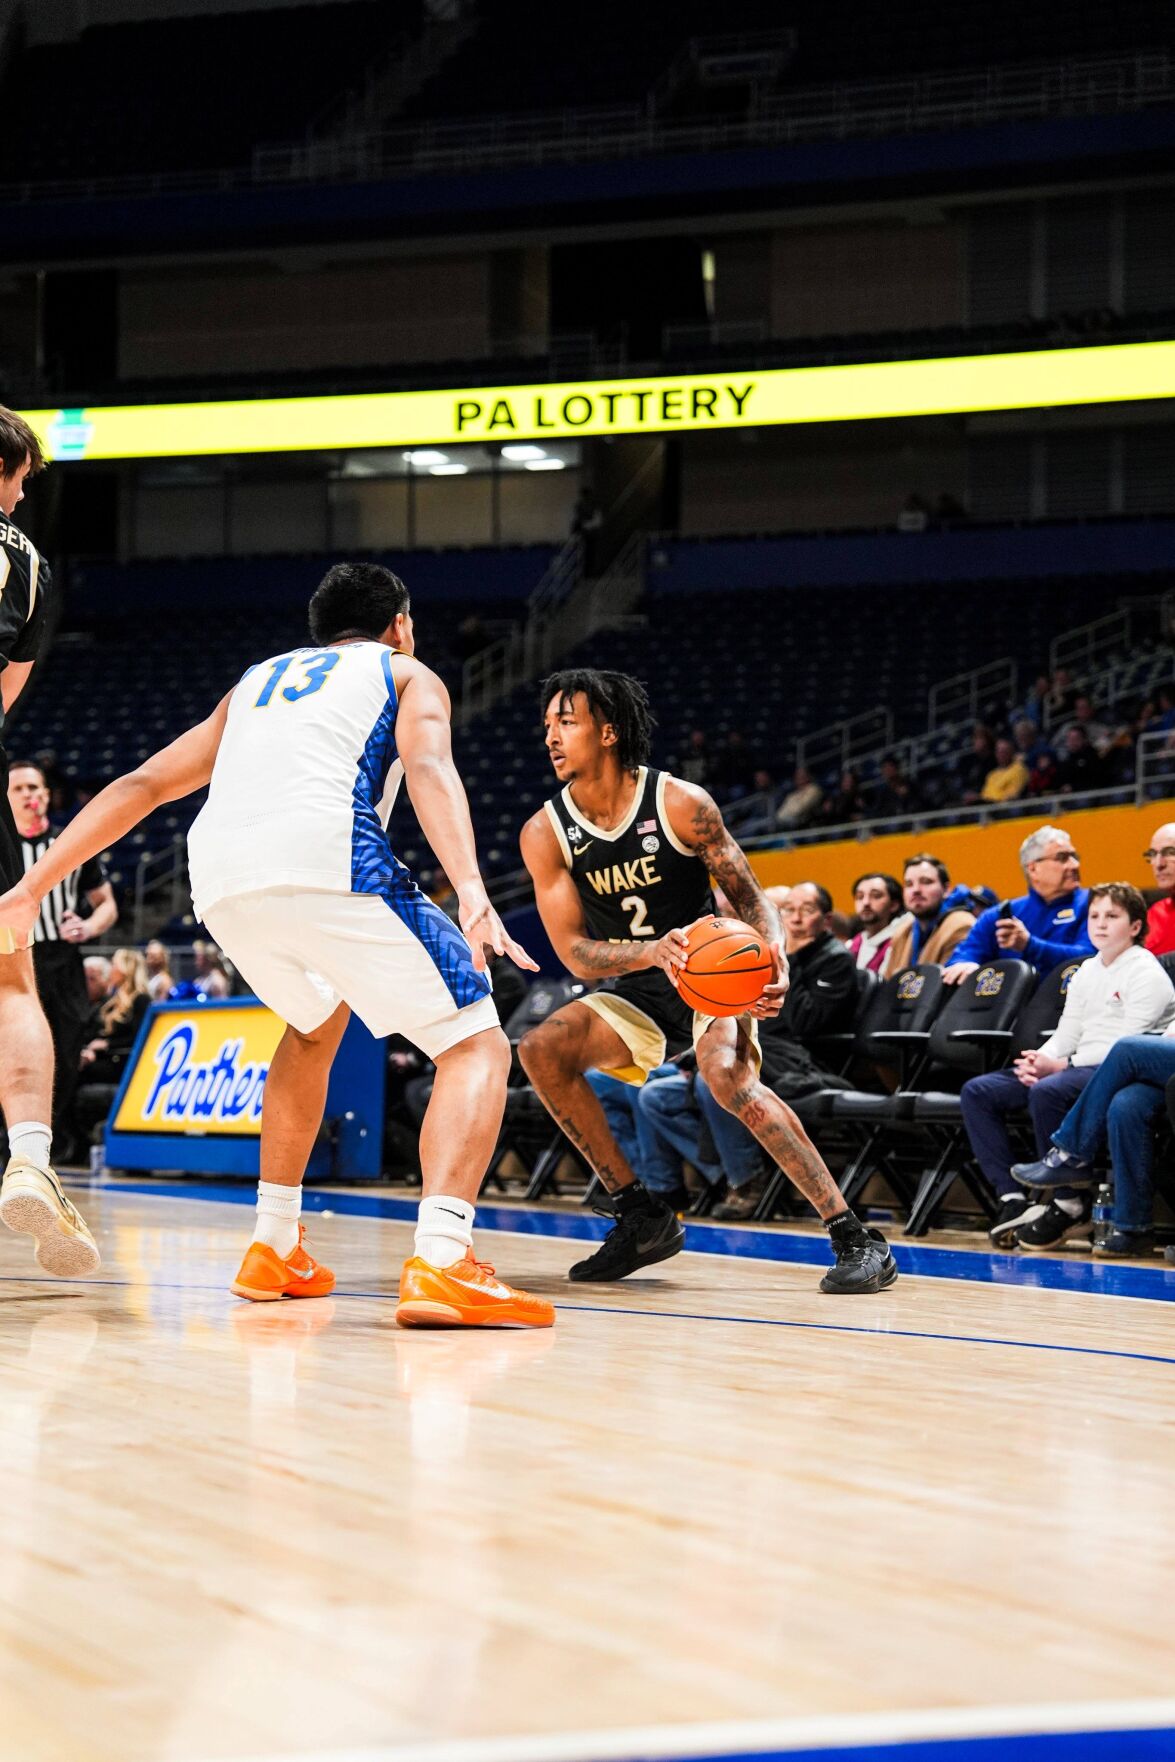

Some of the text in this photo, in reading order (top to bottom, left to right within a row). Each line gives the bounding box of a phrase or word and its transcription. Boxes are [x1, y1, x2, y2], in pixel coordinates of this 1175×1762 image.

[457, 384, 754, 432] PA LOTTERY
[252, 651, 342, 708] 13
[585, 854, 662, 895] WAKE
[620, 895, 656, 937] 2
